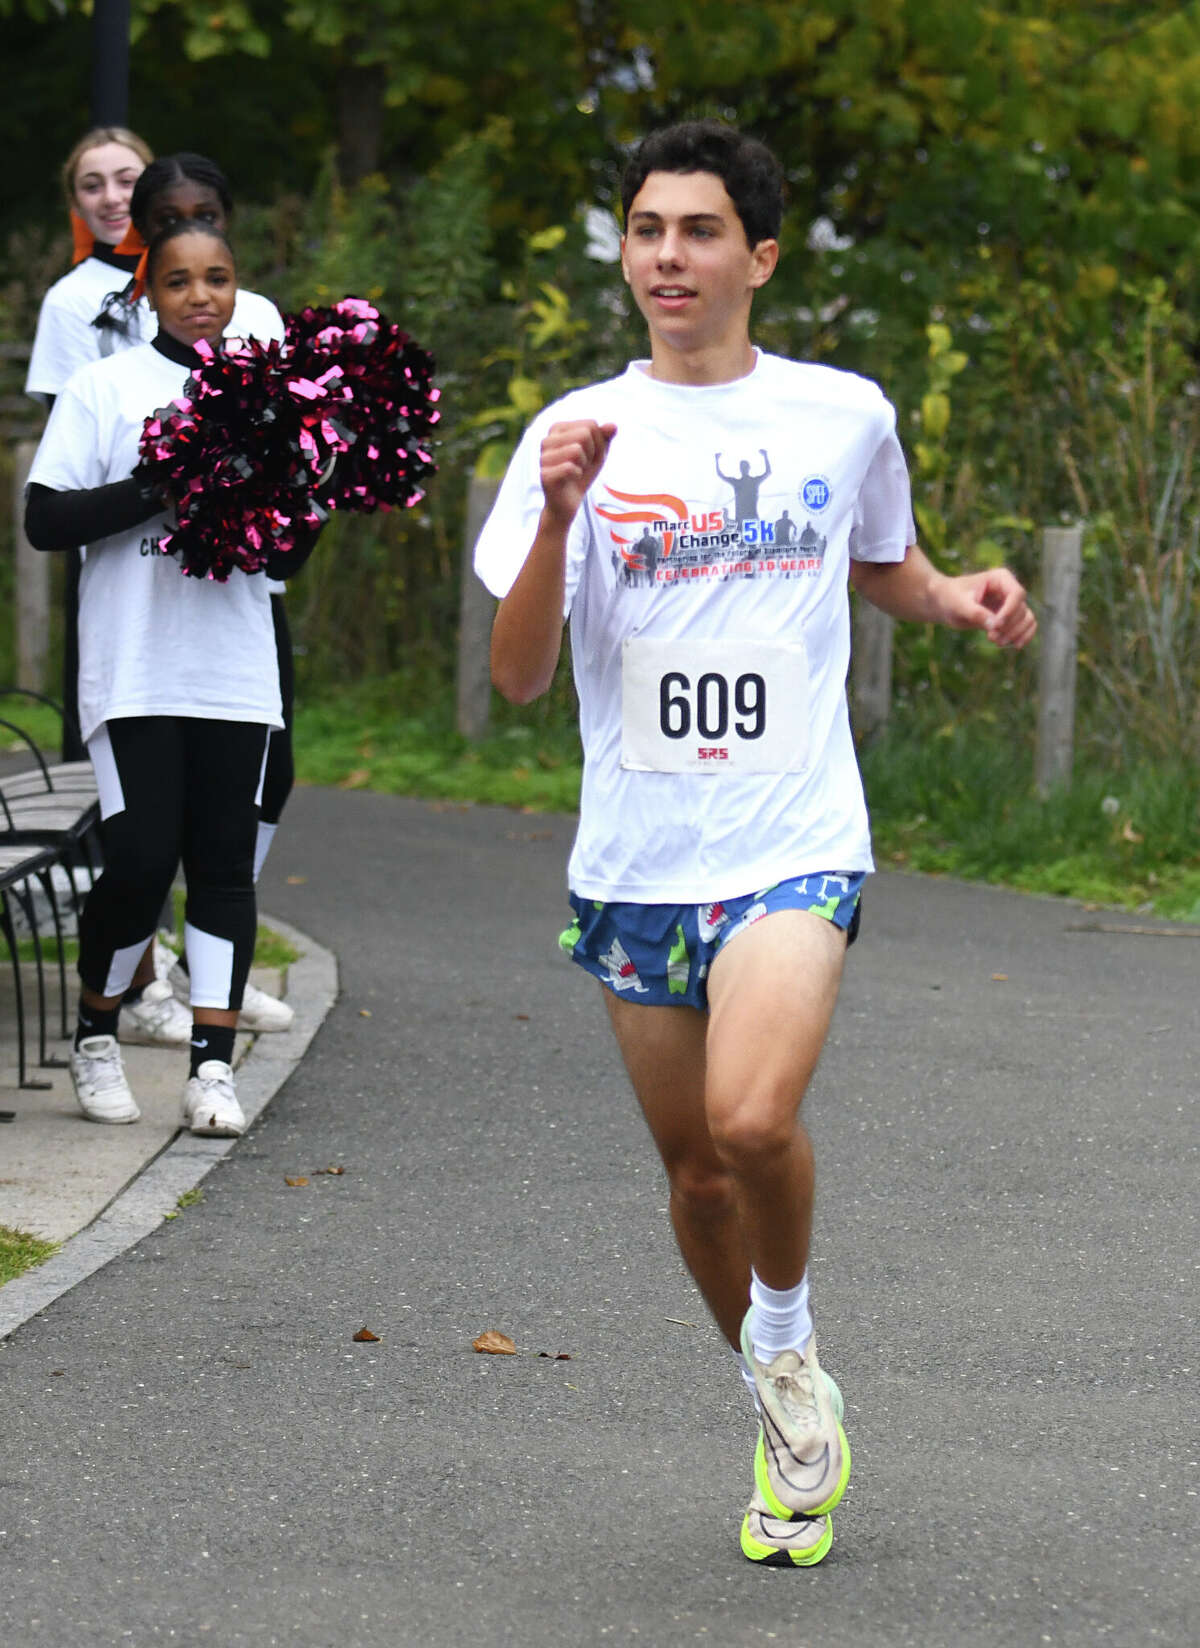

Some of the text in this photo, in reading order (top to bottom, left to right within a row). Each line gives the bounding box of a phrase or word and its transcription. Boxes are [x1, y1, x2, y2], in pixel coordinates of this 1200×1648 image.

[680, 532, 739, 548] Change
[656, 561, 752, 581] CELEBRATING
[758, 560, 776, 572] 10
[659, 671, 767, 740] 609
[697, 747, 729, 760] SRS
